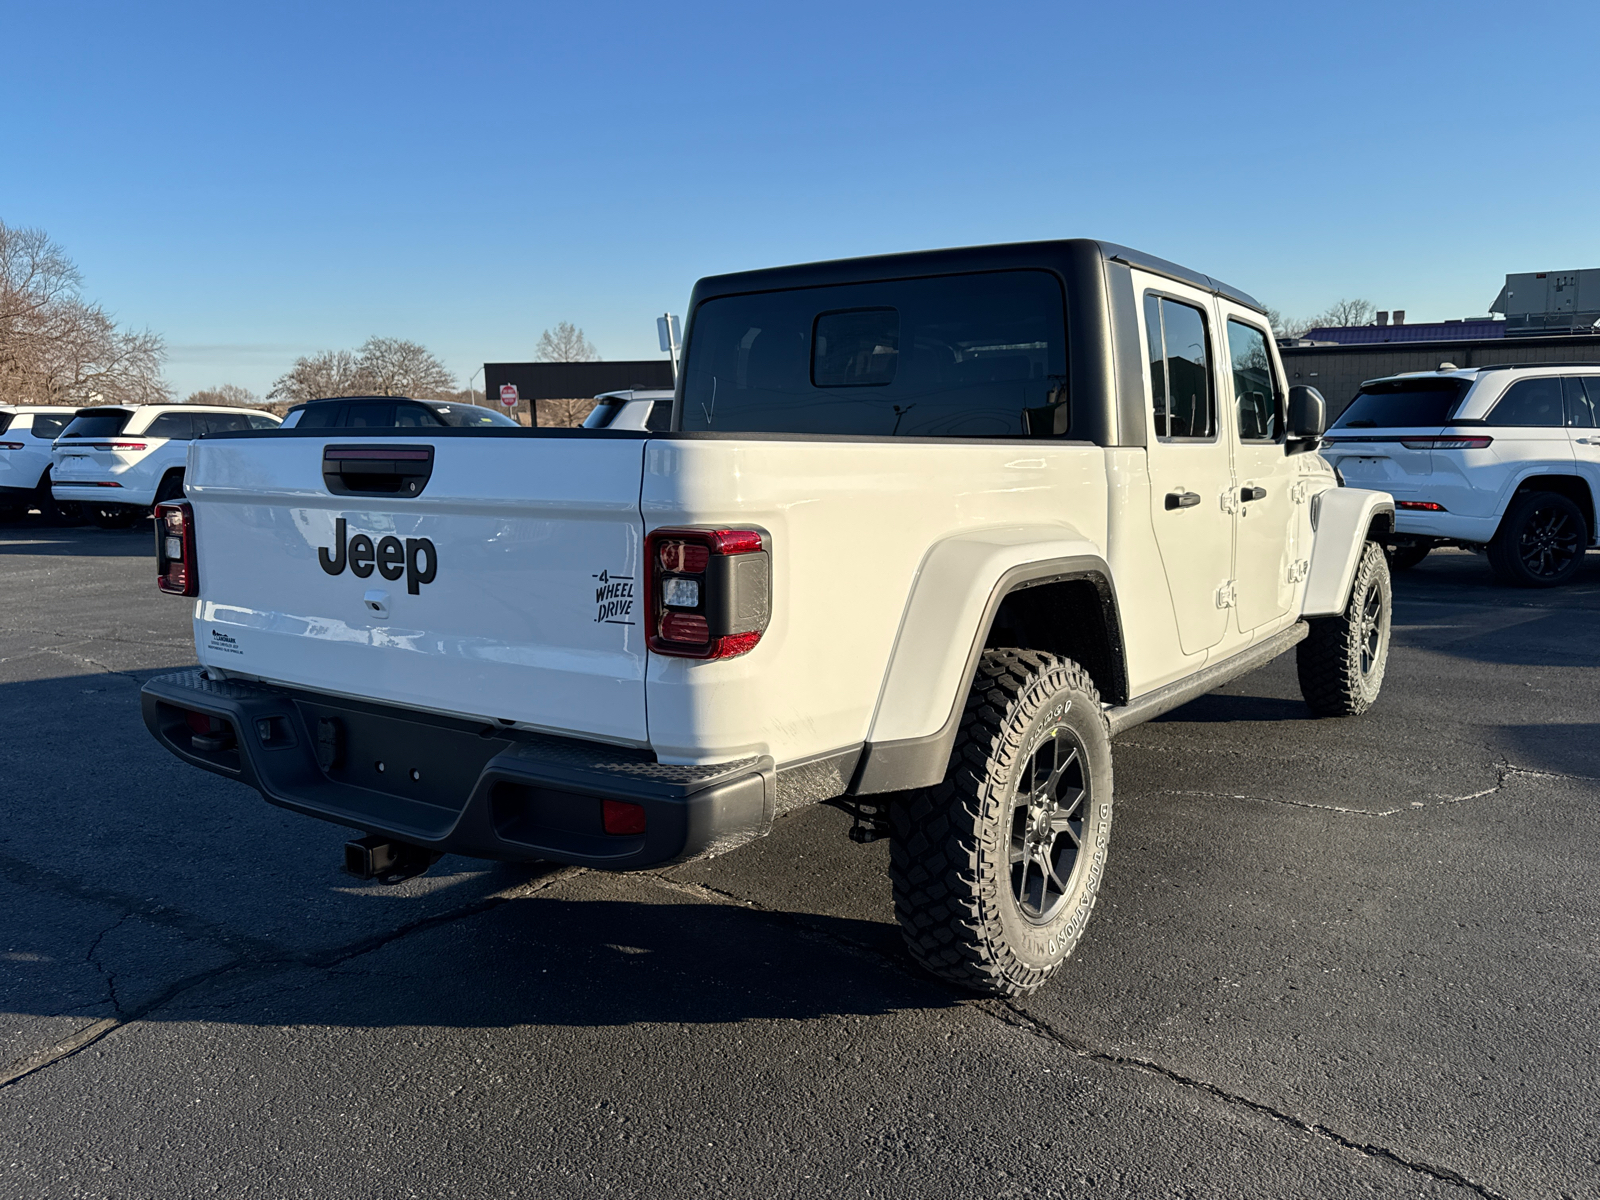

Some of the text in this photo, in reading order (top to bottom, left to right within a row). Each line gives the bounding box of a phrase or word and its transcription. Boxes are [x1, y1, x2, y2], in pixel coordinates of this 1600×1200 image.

[318, 517, 438, 596] Jeep
[599, 569, 609, 584] 4
[596, 582, 633, 604] WHEEL
[597, 599, 633, 623] DRIVE
[1055, 803, 1109, 949] DESTINATION
